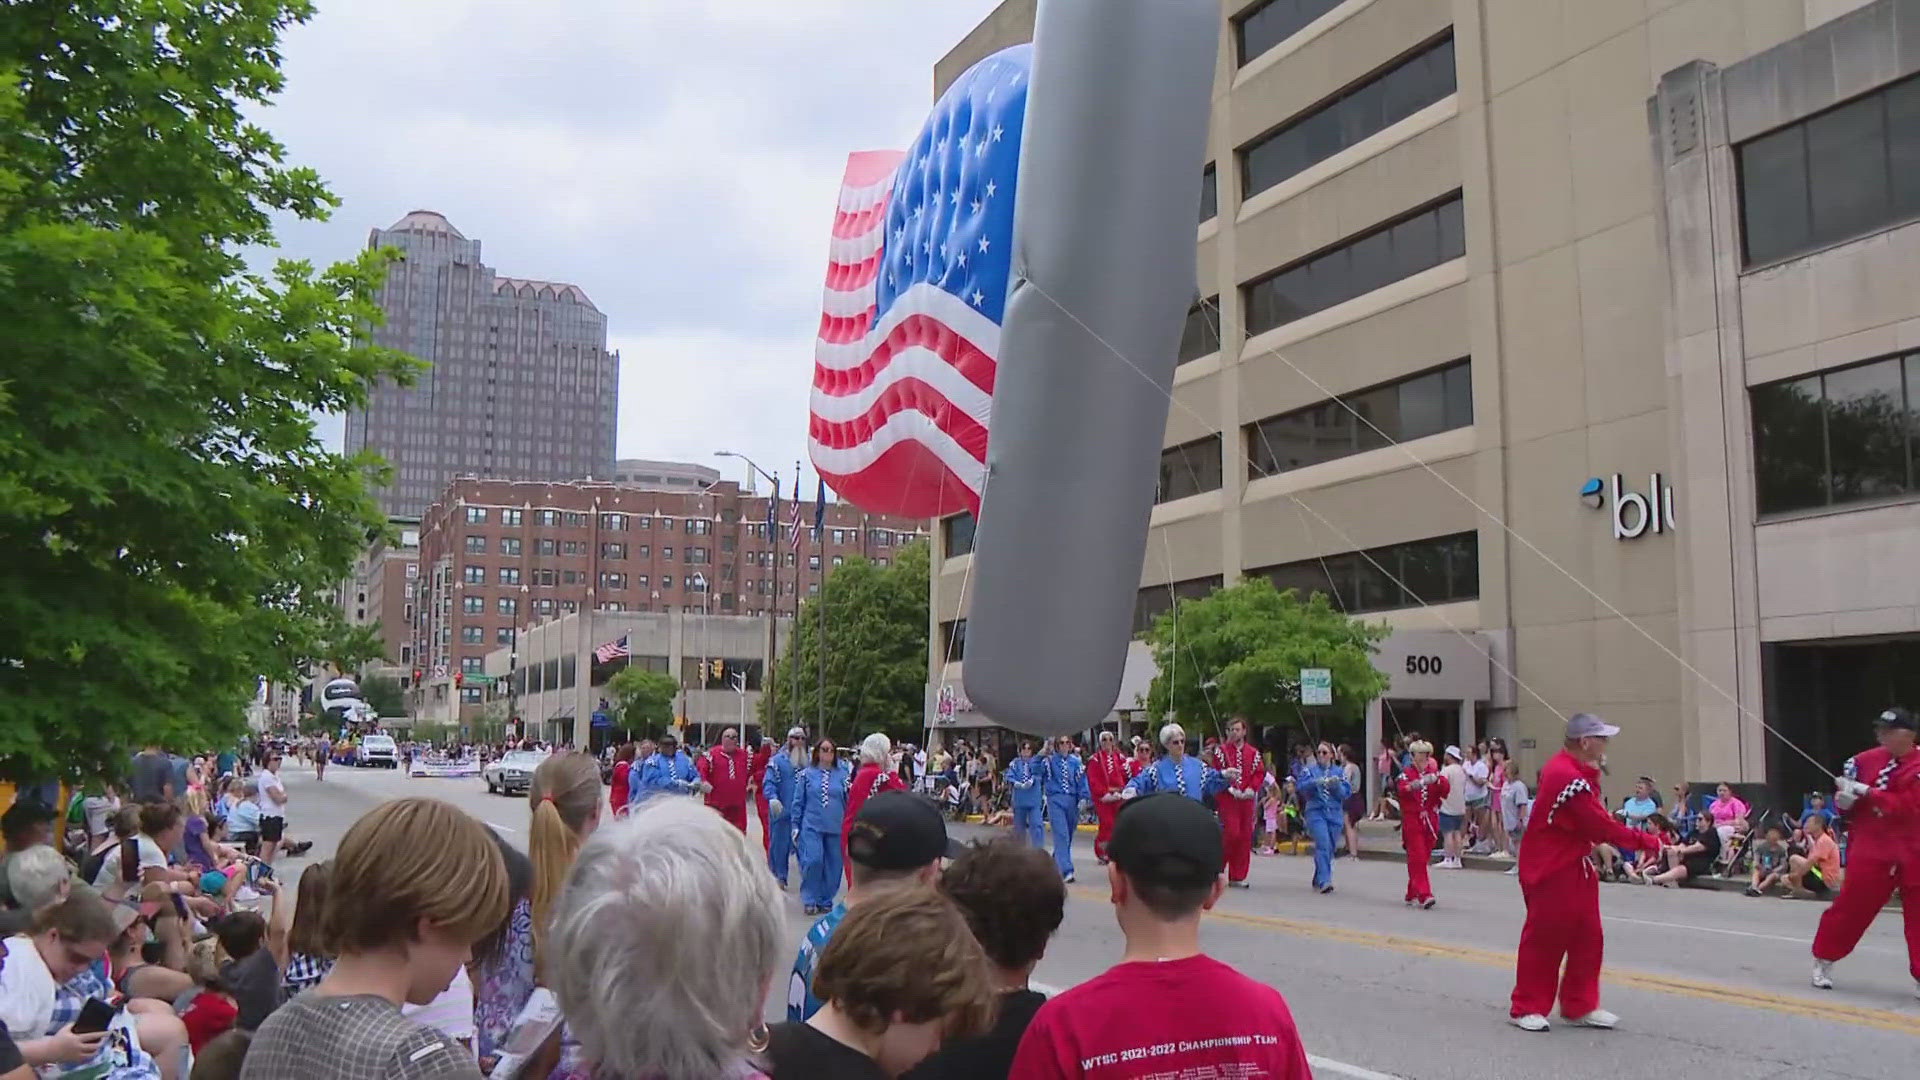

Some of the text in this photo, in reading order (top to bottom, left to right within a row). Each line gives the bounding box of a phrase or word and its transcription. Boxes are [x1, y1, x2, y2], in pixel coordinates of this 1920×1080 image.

[1406, 655, 1442, 674] 500
[1081, 1034, 1278, 1070] WTSC 2021-2022 CHAMPIONSHIP TEAM
